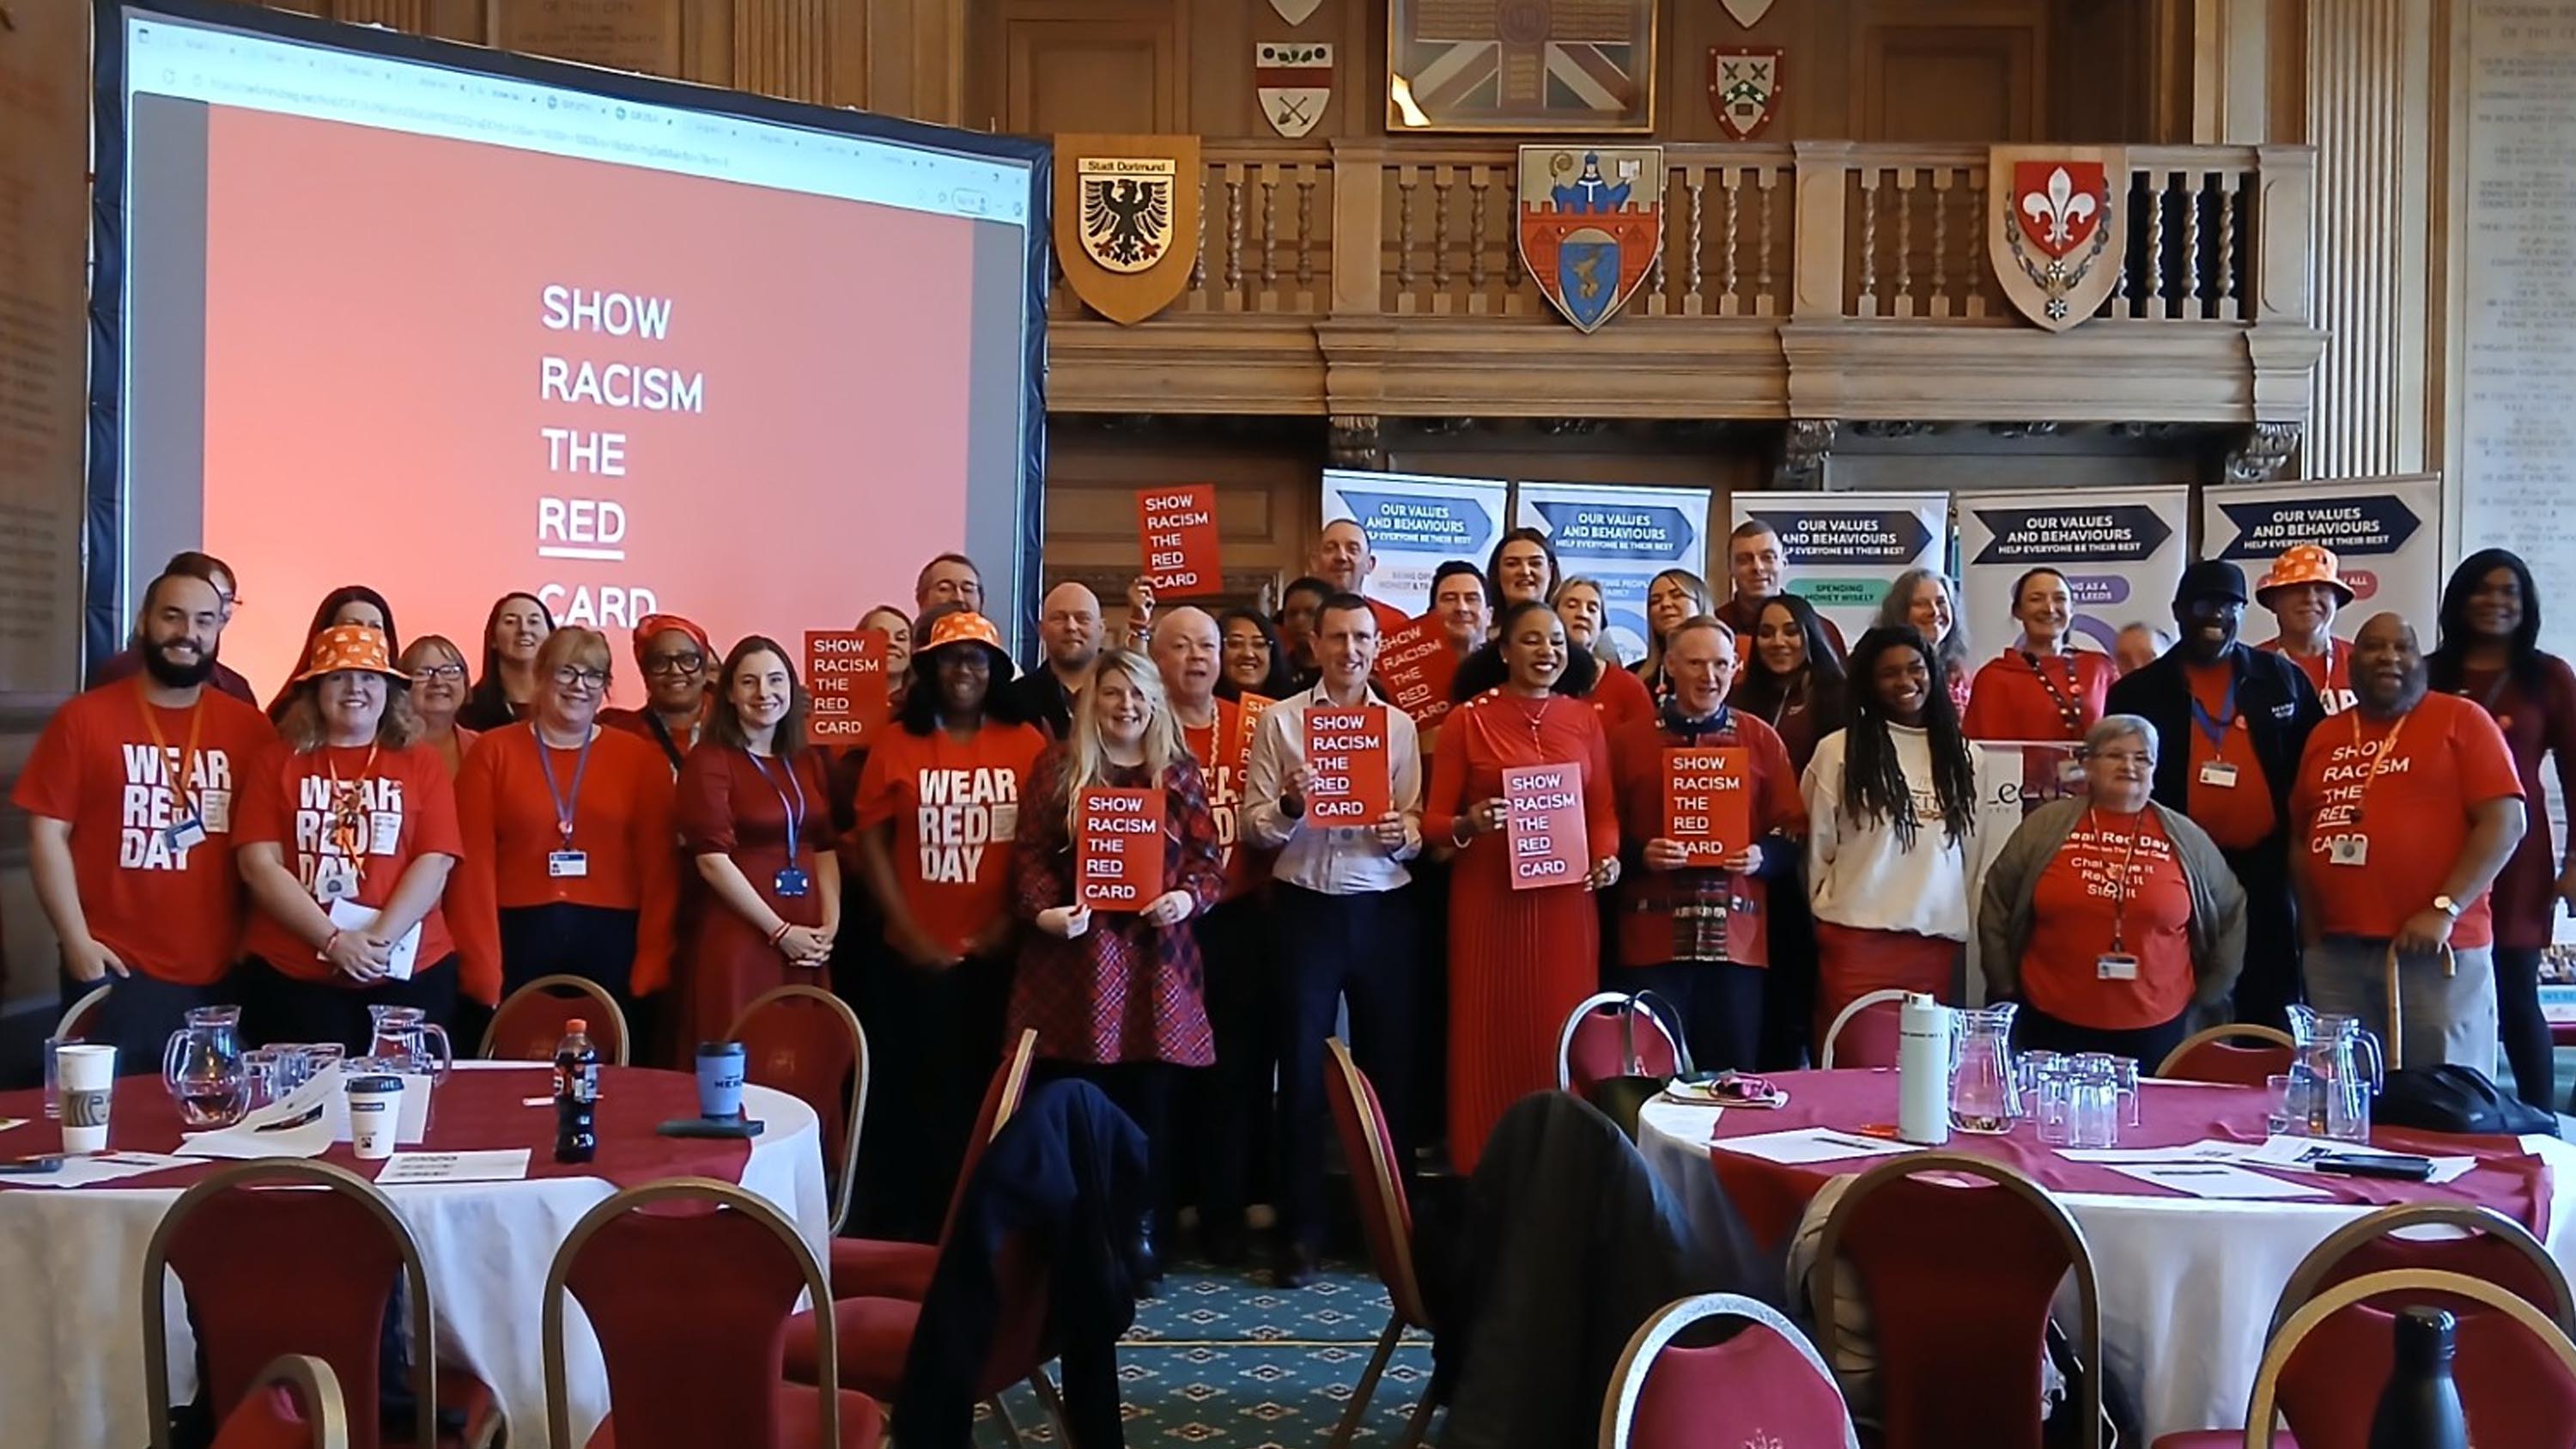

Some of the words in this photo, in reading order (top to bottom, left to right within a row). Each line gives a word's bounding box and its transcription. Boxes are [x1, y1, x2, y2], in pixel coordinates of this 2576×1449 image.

[1088, 160, 1115, 171] Stadt
[1117, 161, 1165, 172] Dortmund
[542, 284, 672, 340] SHOW
[541, 356, 704, 414] RACISM
[540, 427, 627, 476] THE
[1145, 495, 1194, 511] SHOW
[1381, 503, 1406, 516] OUR
[1408, 505, 1449, 519] VALUES
[538, 497, 626, 544] RED
[1147, 512, 1209, 530] RACISM
[1578, 513, 1605, 525] OUR
[1606, 514, 1651, 527] VALUES
[2026, 517, 2058, 530] OUR
[2060, 514, 2113, 528] VALUES
[2273, 510, 2305, 523] OUR
[2307, 507, 2361, 521] VALUES
[1366, 516, 1392, 529] AND
[1394, 517, 1465, 533] BEHAVIOURS
[1563, 525, 1589, 538] AND
[1591, 527, 1667, 540] BEHAVIOURS
[1797, 520, 1826, 532] OUR
[1829, 520, 1879, 532] VALUES
[2252, 525, 2285, 539] AND
[2287, 520, 2381, 537] BEHAVIOURS
[1151, 533, 1182, 547] THE
[1782, 533, 1809, 545] AND
[1812, 533, 1898, 545] BEHAVIOURS
[2007, 531, 2039, 544] AND
[2041, 528, 2133, 543] BEHAVIOURS
[2244, 540, 2268, 550] HELP
[2321, 537, 2334, 546] BE
[2336, 535, 2364, 545] THEIR
[2366, 534, 2390, 545] BEST
[1795, 546, 1842, 556] EVERYONE
[1856, 546, 1881, 556] THEIR
[1883, 546, 1905, 556] BEST
[1998, 545, 2022, 555] HELP
[2023, 544, 2073, 554] EVERYONE
[2075, 543, 2087, 553] BE
[2088, 542, 2116, 552] THEIR
[2117, 542, 2142, 552] BEST
[1151, 551, 1184, 567] RED
[1154, 571, 1198, 589] CARD
[538, 584, 657, 628] CARD
[814, 639, 866, 653] SHOW
[1376, 625, 1423, 654] SHOW
[1382, 639, 1443, 671] RACISM
[814, 658, 879, 673] RACISM
[815, 677, 849, 692] THE
[1389, 666, 1423, 687] THE
[1397, 684, 1430, 704] RED
[815, 697, 850, 710] RED
[1409, 700, 1450, 723] CARD
[815, 721, 863, 735] CARD
[1312, 715, 1365, 731] SHOW
[1313, 736, 1381, 752] RACISM
[2331, 739, 2398, 761] SHOW
[122, 743, 232, 789] WEAR
[1315, 756, 1349, 770] THE
[1673, 757, 1726, 770] SHOW
[2323, 757, 2410, 782] RACSM
[919, 767, 1018, 805] WEAR
[1315, 776, 1350, 791] RED
[1512, 774, 1562, 790] SHOW
[1673, 776, 1741, 790] RACISM
[2323, 784, 2364, 803] THE
[1088, 796, 1144, 813] SHOW
[1315, 801, 1364, 816] CARD
[1514, 792, 1577, 812] RACISM
[1674, 795, 1710, 811] THE
[918, 804, 988, 845] RED
[1087, 818, 1157, 834] RACISM
[1516, 816, 1550, 831] THE
[1674, 815, 1710, 830] RED
[1088, 838, 1124, 854] THE
[1517, 837, 1551, 852] RED
[2140, 836, 2170, 852] Day
[920, 845, 985, 884] DAY
[1086, 859, 1123, 874] RED
[1519, 860, 1566, 877] CARD
[2134, 875, 2144, 886] It
[1085, 885, 1137, 899] CARD
[2126, 888, 2136, 899] It
